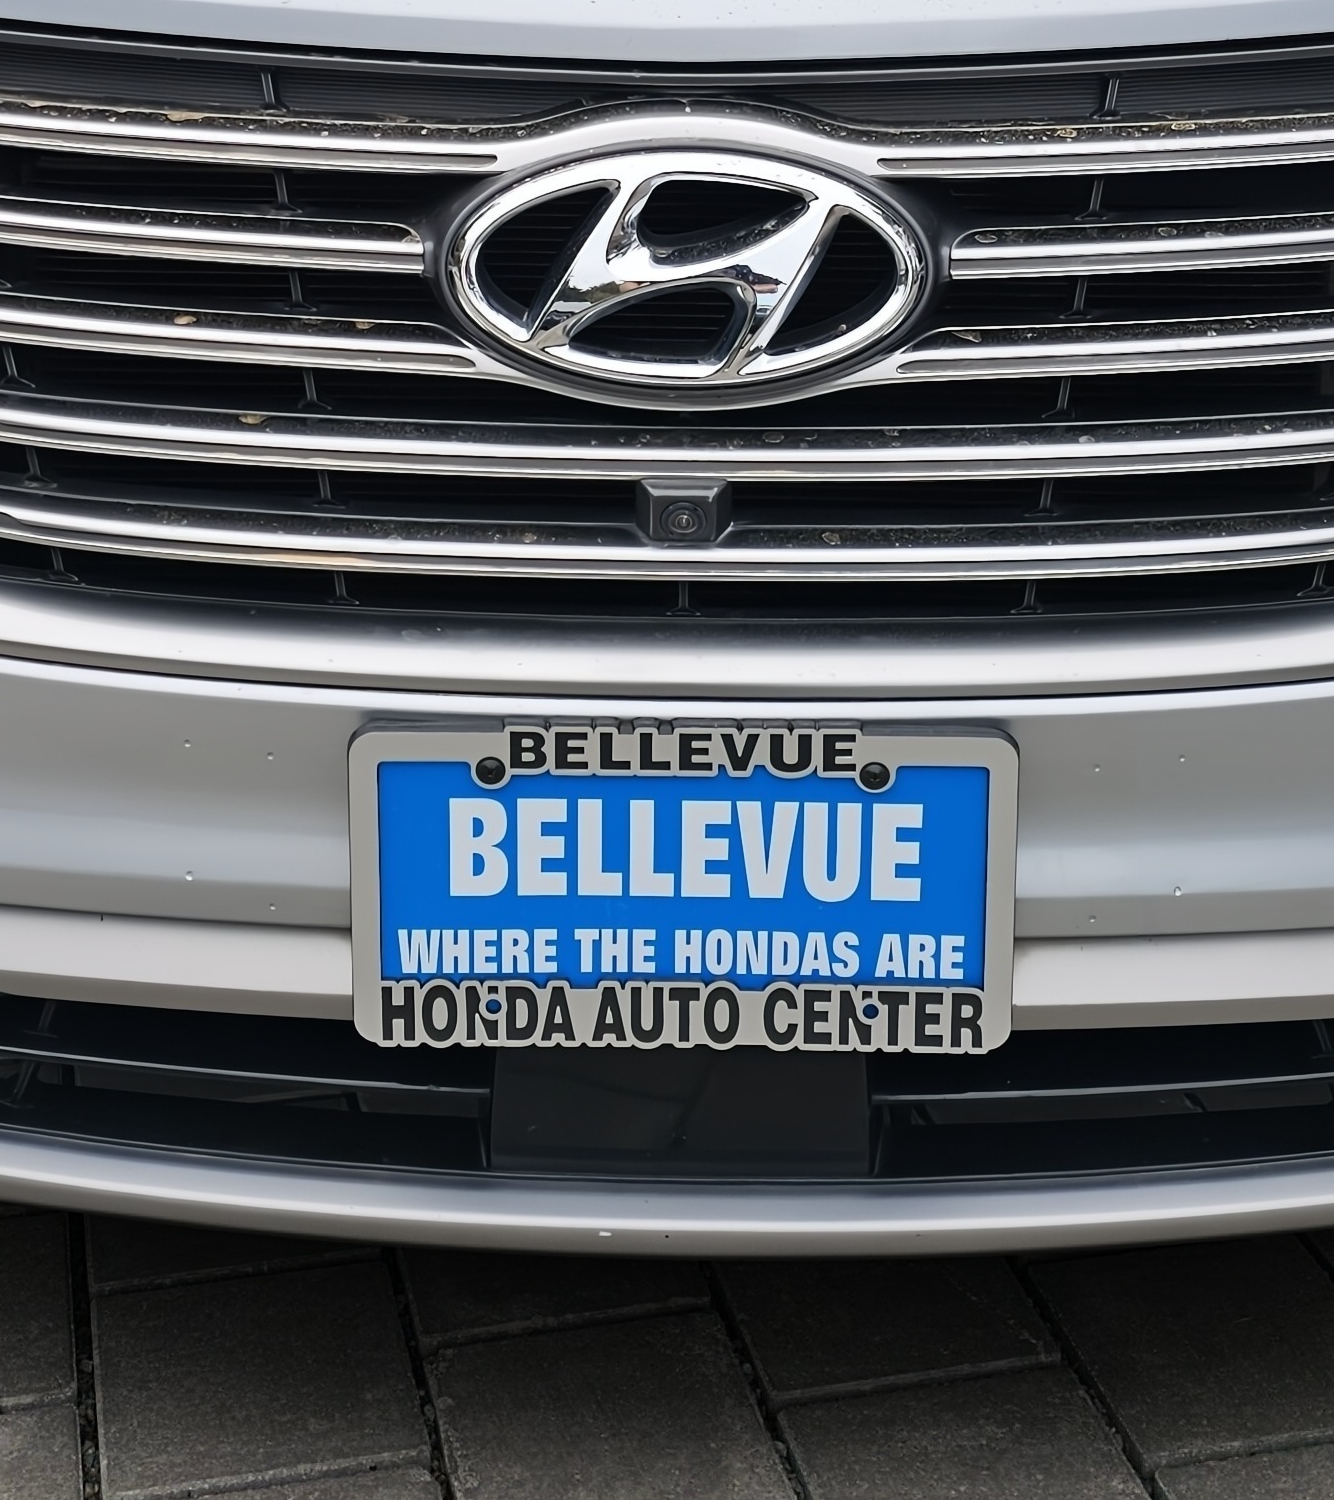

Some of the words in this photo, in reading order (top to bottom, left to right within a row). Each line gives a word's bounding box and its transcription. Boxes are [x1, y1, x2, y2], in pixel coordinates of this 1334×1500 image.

[509, 731, 857, 774] BELLEVUE
[449, 797, 924, 902] BELLEVUE
[397, 928, 558, 974] WHERE
[574, 928, 657, 974] THE
[674, 929, 860, 977] HONDAS
[874, 933, 965, 980] ARE
[381, 984, 576, 1043] HONDA
[592, 986, 740, 1045] AUTO
[763, 987, 983, 1049] CENTER
